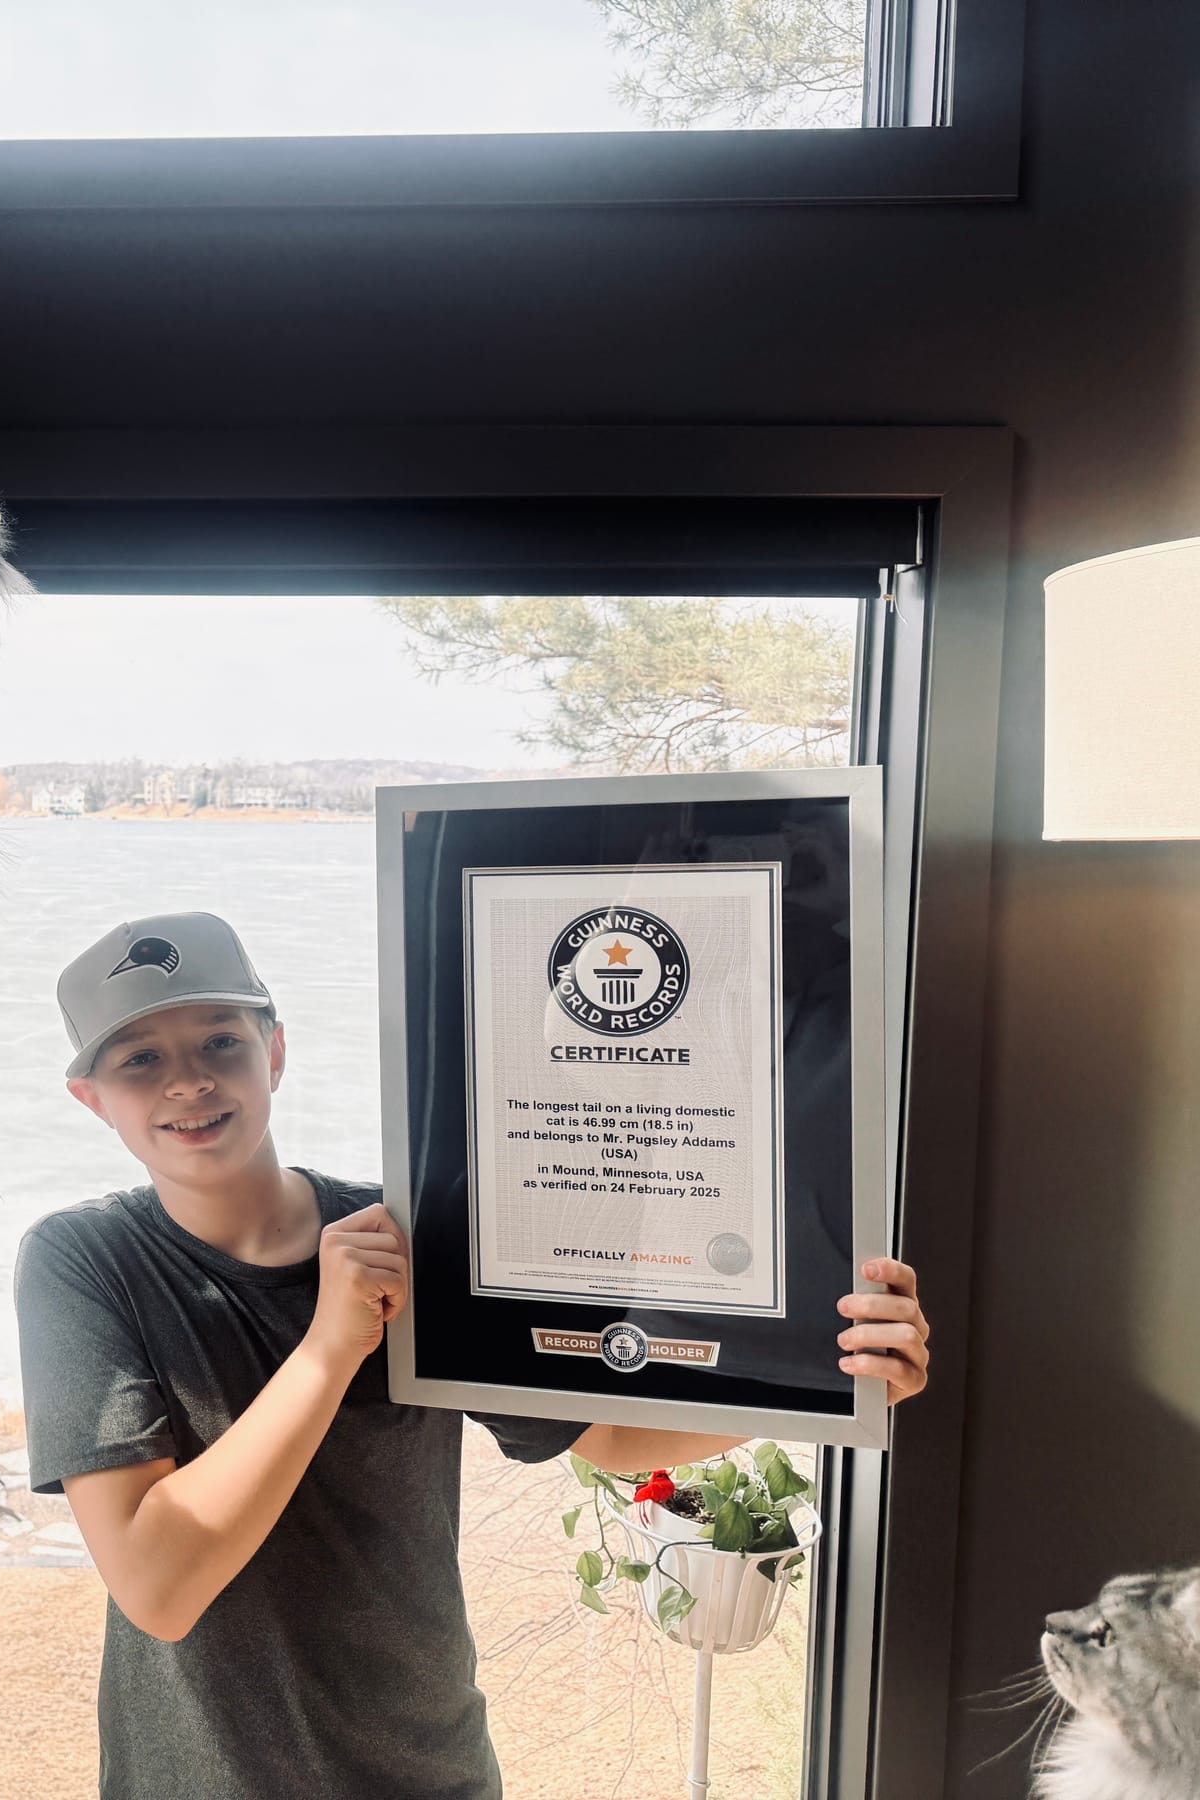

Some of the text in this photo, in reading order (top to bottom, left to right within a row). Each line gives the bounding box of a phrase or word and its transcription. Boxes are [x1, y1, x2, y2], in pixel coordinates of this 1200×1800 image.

[568, 914, 669, 949] GUINNESS
[557, 963, 681, 1029] WORLD RECORDS
[550, 1045, 690, 1063] CERTIFICATE
[507, 1099, 736, 1117] The longest tail on a living domestic
[546, 1116, 694, 1133] cat is 46.99 cm (18.5 in)
[507, 1130, 736, 1148] and belongs to Mr. Pugsley Addams
[601, 1148, 638, 1161] (USA)
[537, 1164, 704, 1181] in Mound, Minnesota, USA
[523, 1179, 721, 1198] as verified on 24 February 2025
[553, 1247, 692, 1265] OFFICIALLY AMAZING
[607, 1328, 640, 1341] GUINNESS
[544, 1336, 705, 1358] RECORD HOLDER
[603, 1343, 644, 1366] WORLD RECORDS
